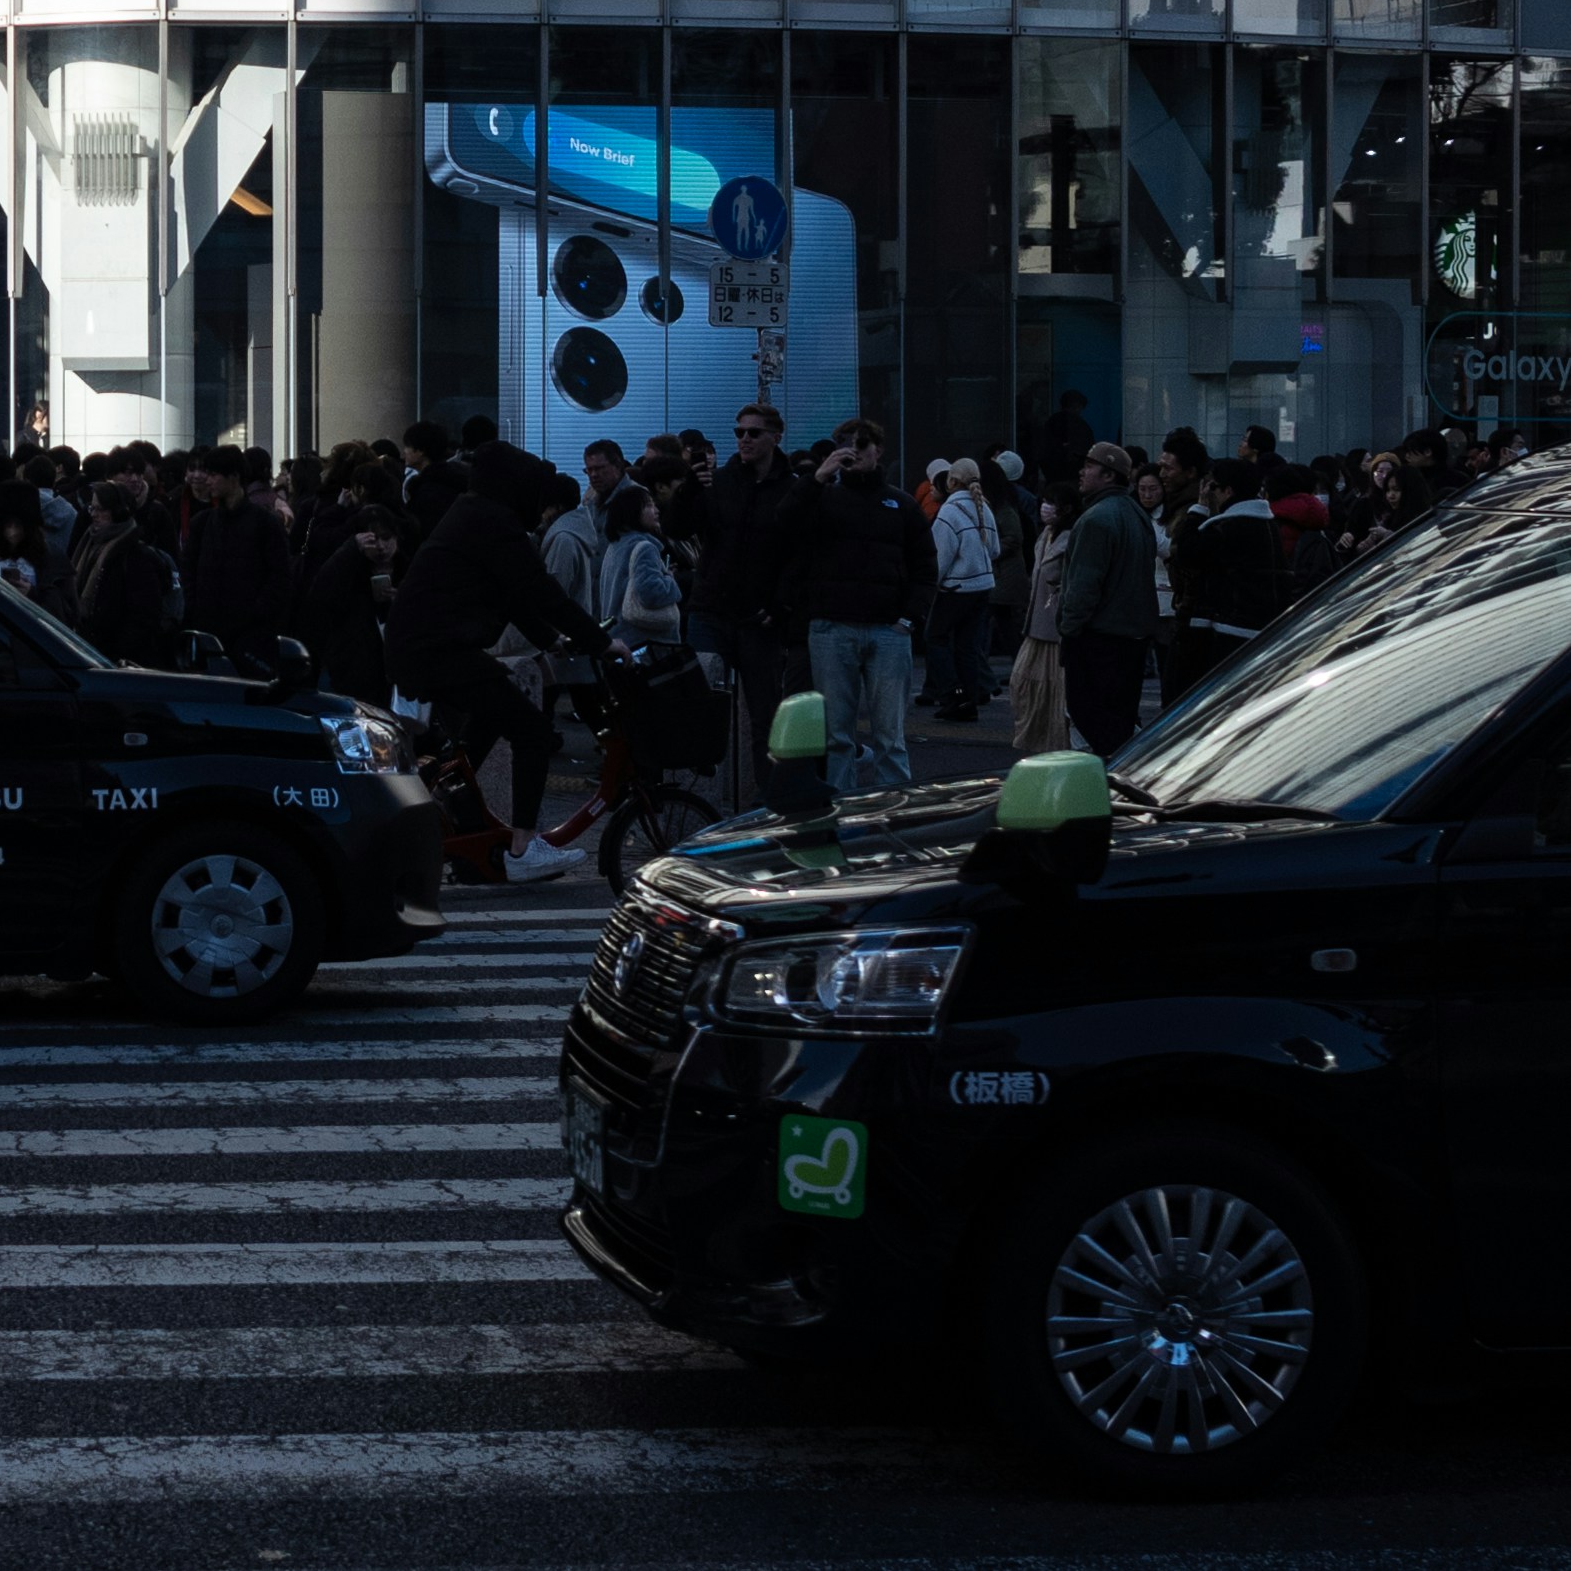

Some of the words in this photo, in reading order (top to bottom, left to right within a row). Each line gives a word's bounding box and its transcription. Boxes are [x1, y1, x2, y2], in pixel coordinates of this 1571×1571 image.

[569, 136, 600, 158] Now
[603, 146, 636, 168] Brief
[719, 266, 734, 283] 15
[770, 268, 780, 284] 5
[718, 306, 733, 323] 12
[770, 307, 779, 323] 5
[1462, 348, 1571, 392] Galaxy
[91, 787, 159, 812] TAXI
